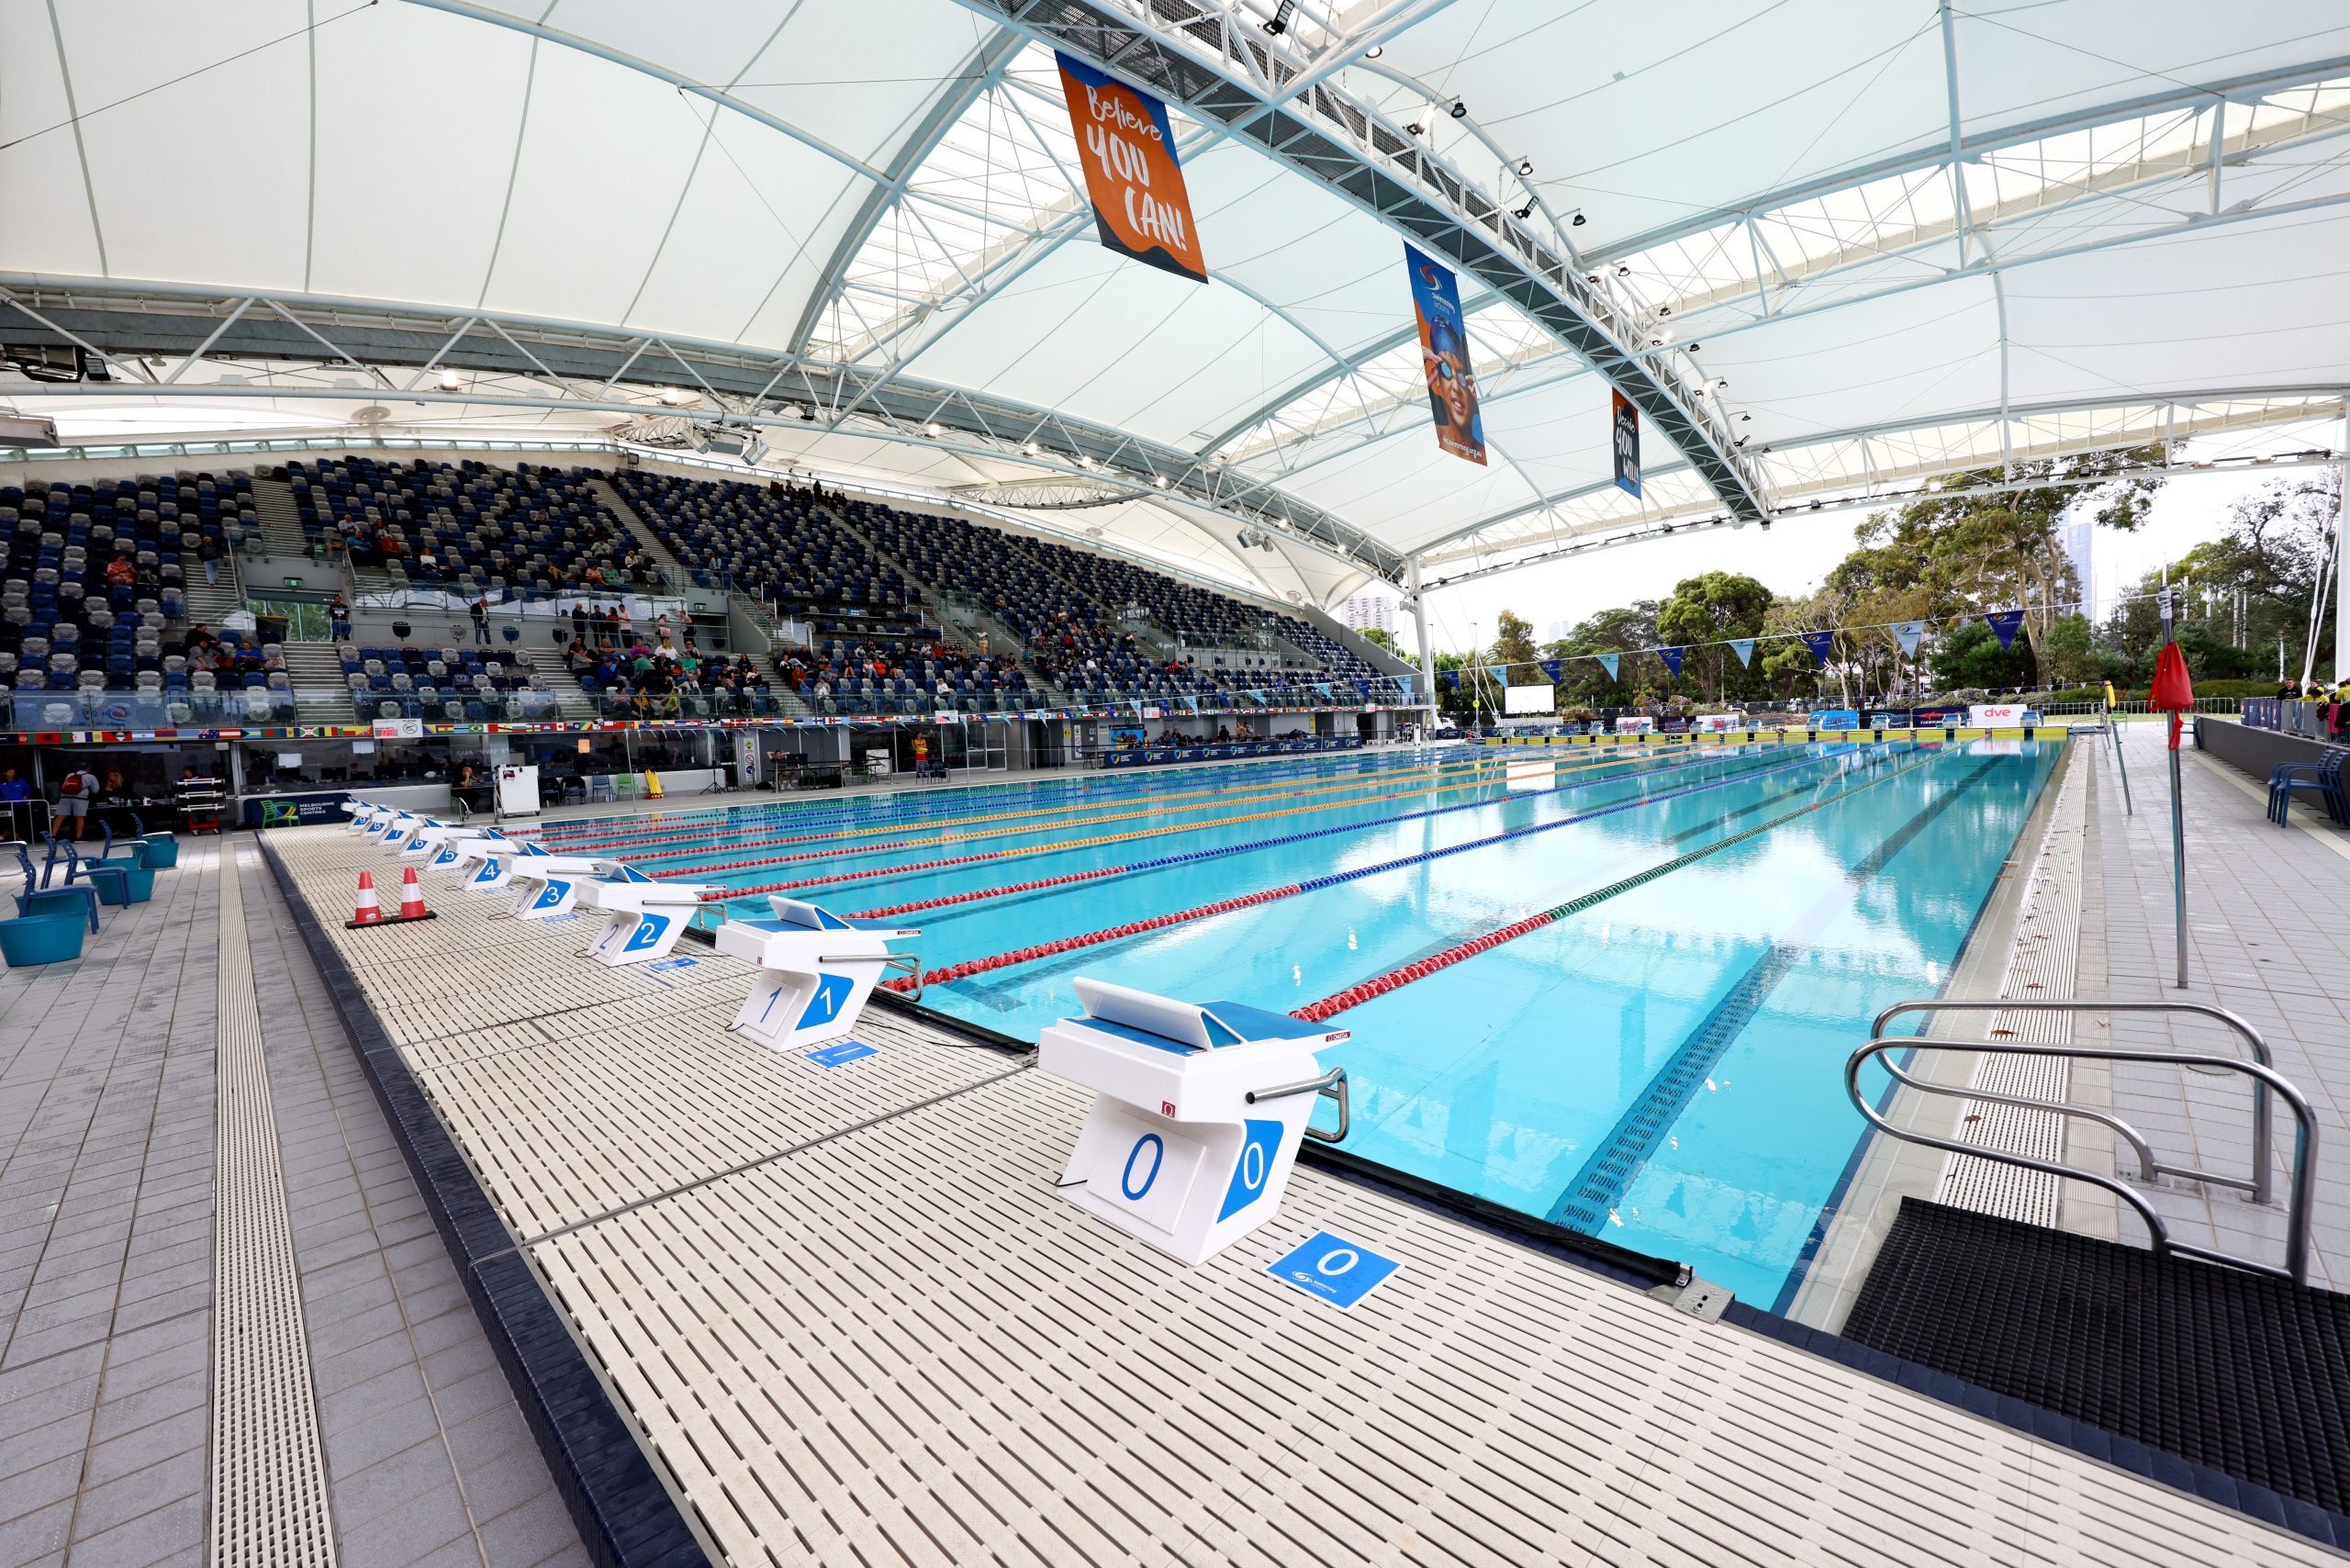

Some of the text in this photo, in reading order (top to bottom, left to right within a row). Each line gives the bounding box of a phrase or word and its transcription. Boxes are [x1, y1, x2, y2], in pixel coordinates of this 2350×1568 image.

[1086, 84, 1163, 141] Believe
[1086, 123, 1150, 187] YOU
[1125, 185, 1187, 252] CAN!
[1617, 405, 1636, 433] Decide
[1616, 426, 1632, 457] YOU
[1984, 708, 2011, 718] dve
[374, 822, 381, 830] 8
[415, 838, 424, 847] 6
[445, 849, 454, 860] 5
[485, 864, 496, 878] 4
[546, 886, 560, 903] 3
[599, 924, 620, 950] 2
[641, 922, 656, 944] 2
[760, 986, 783, 1024] 1
[820, 986, 832, 1015] 1
[1333, 1031, 1348, 1040] OMEGA
[1122, 1133, 1164, 1201] 0
[1243, 1141, 1264, 1191] 0
[1316, 1248, 1360, 1276] 0
